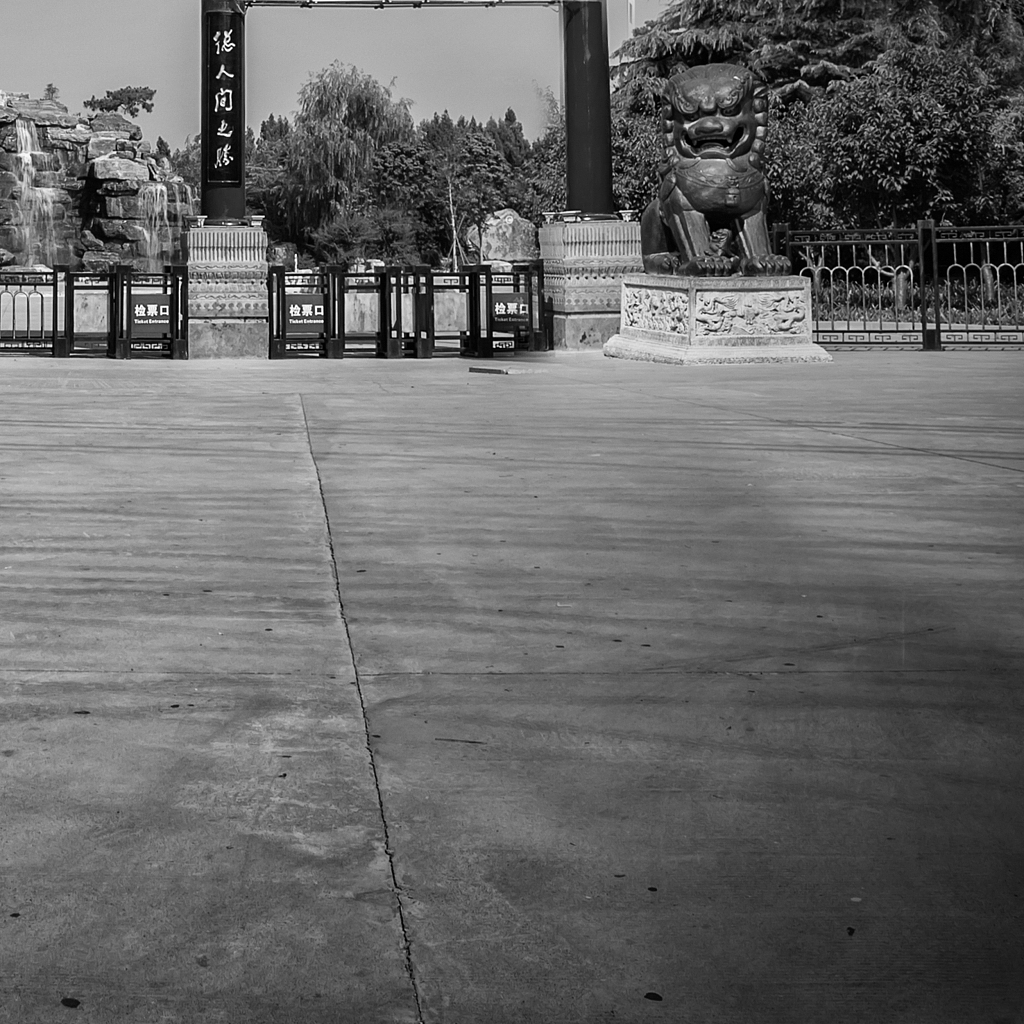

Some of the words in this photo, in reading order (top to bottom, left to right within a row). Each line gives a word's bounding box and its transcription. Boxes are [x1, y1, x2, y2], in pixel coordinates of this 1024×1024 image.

[134, 304, 169, 317] 检票口
[289, 304, 324, 317] 检票口
[494, 302, 529, 315] 检票口
